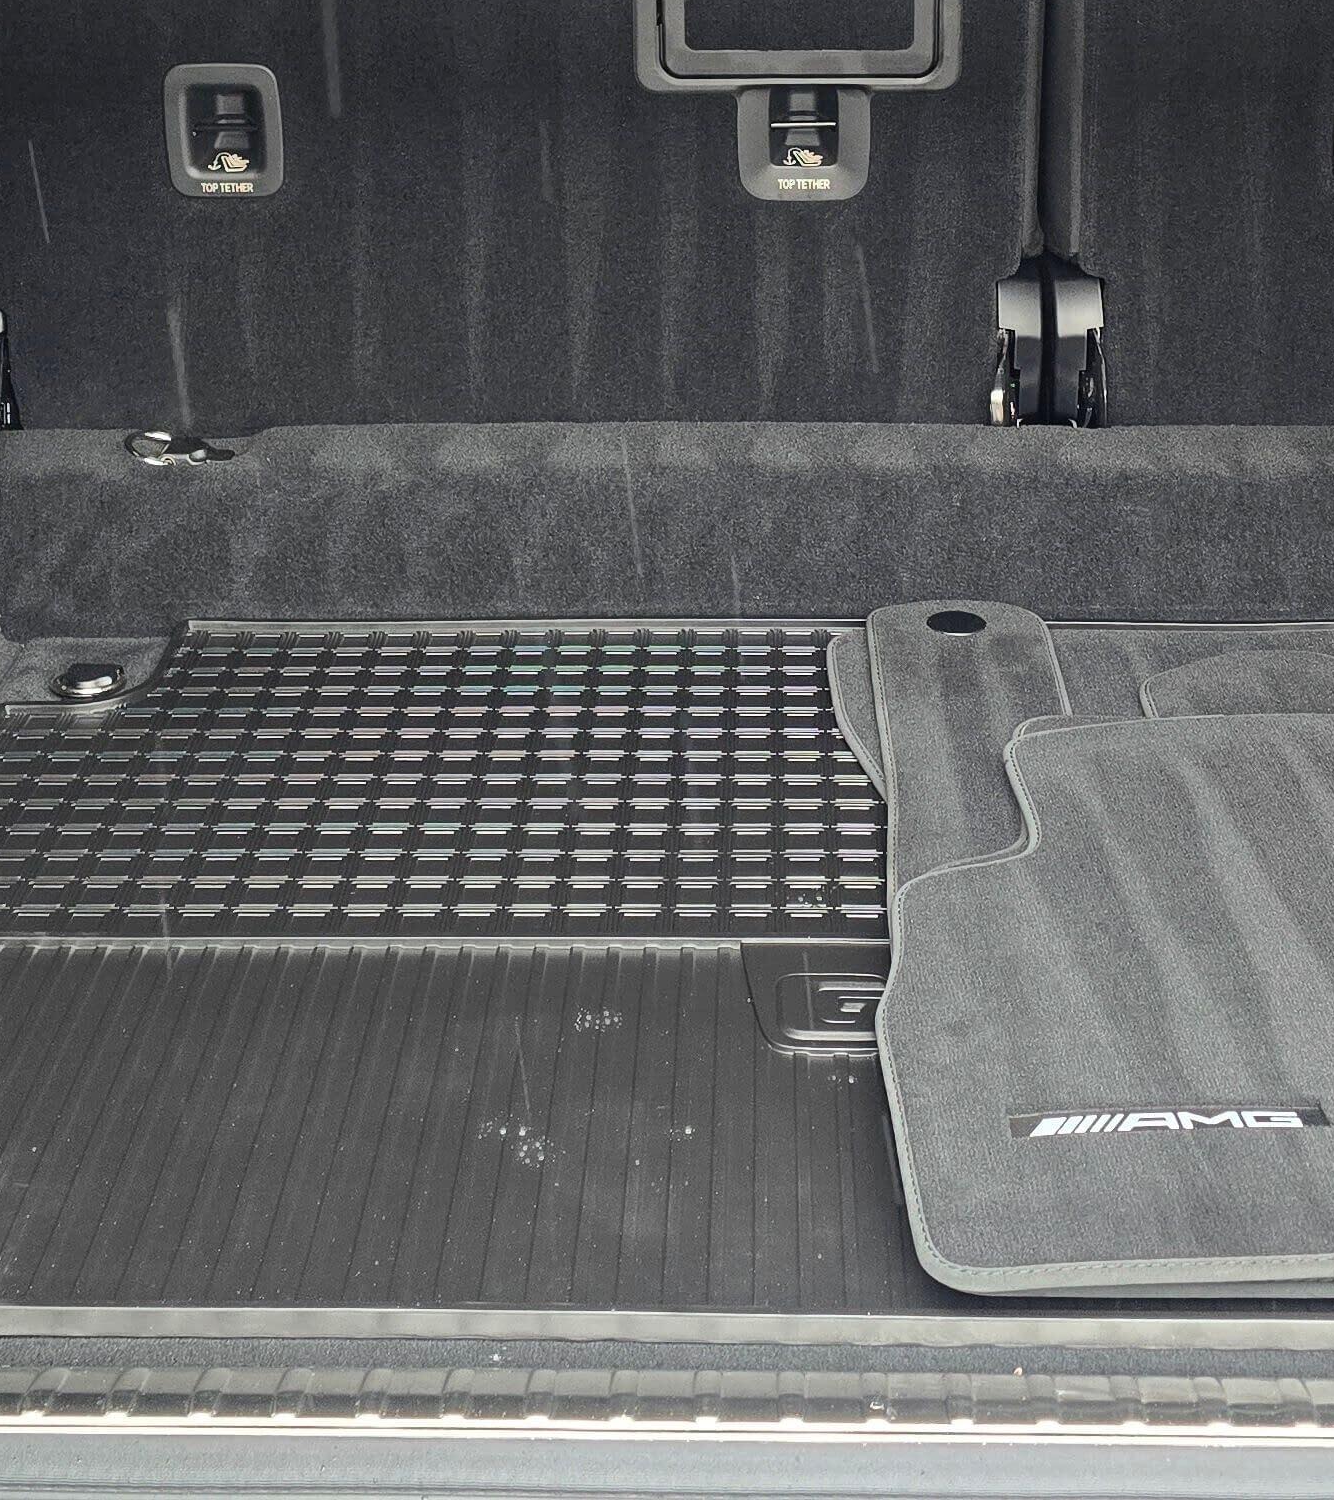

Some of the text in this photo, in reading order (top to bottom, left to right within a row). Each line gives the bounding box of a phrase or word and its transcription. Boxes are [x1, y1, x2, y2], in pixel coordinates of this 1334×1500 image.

[201, 182, 254, 193] TOP TETHER
[778, 179, 830, 189] TOP TETHER
[1117, 1111, 1303, 1131] AMG
